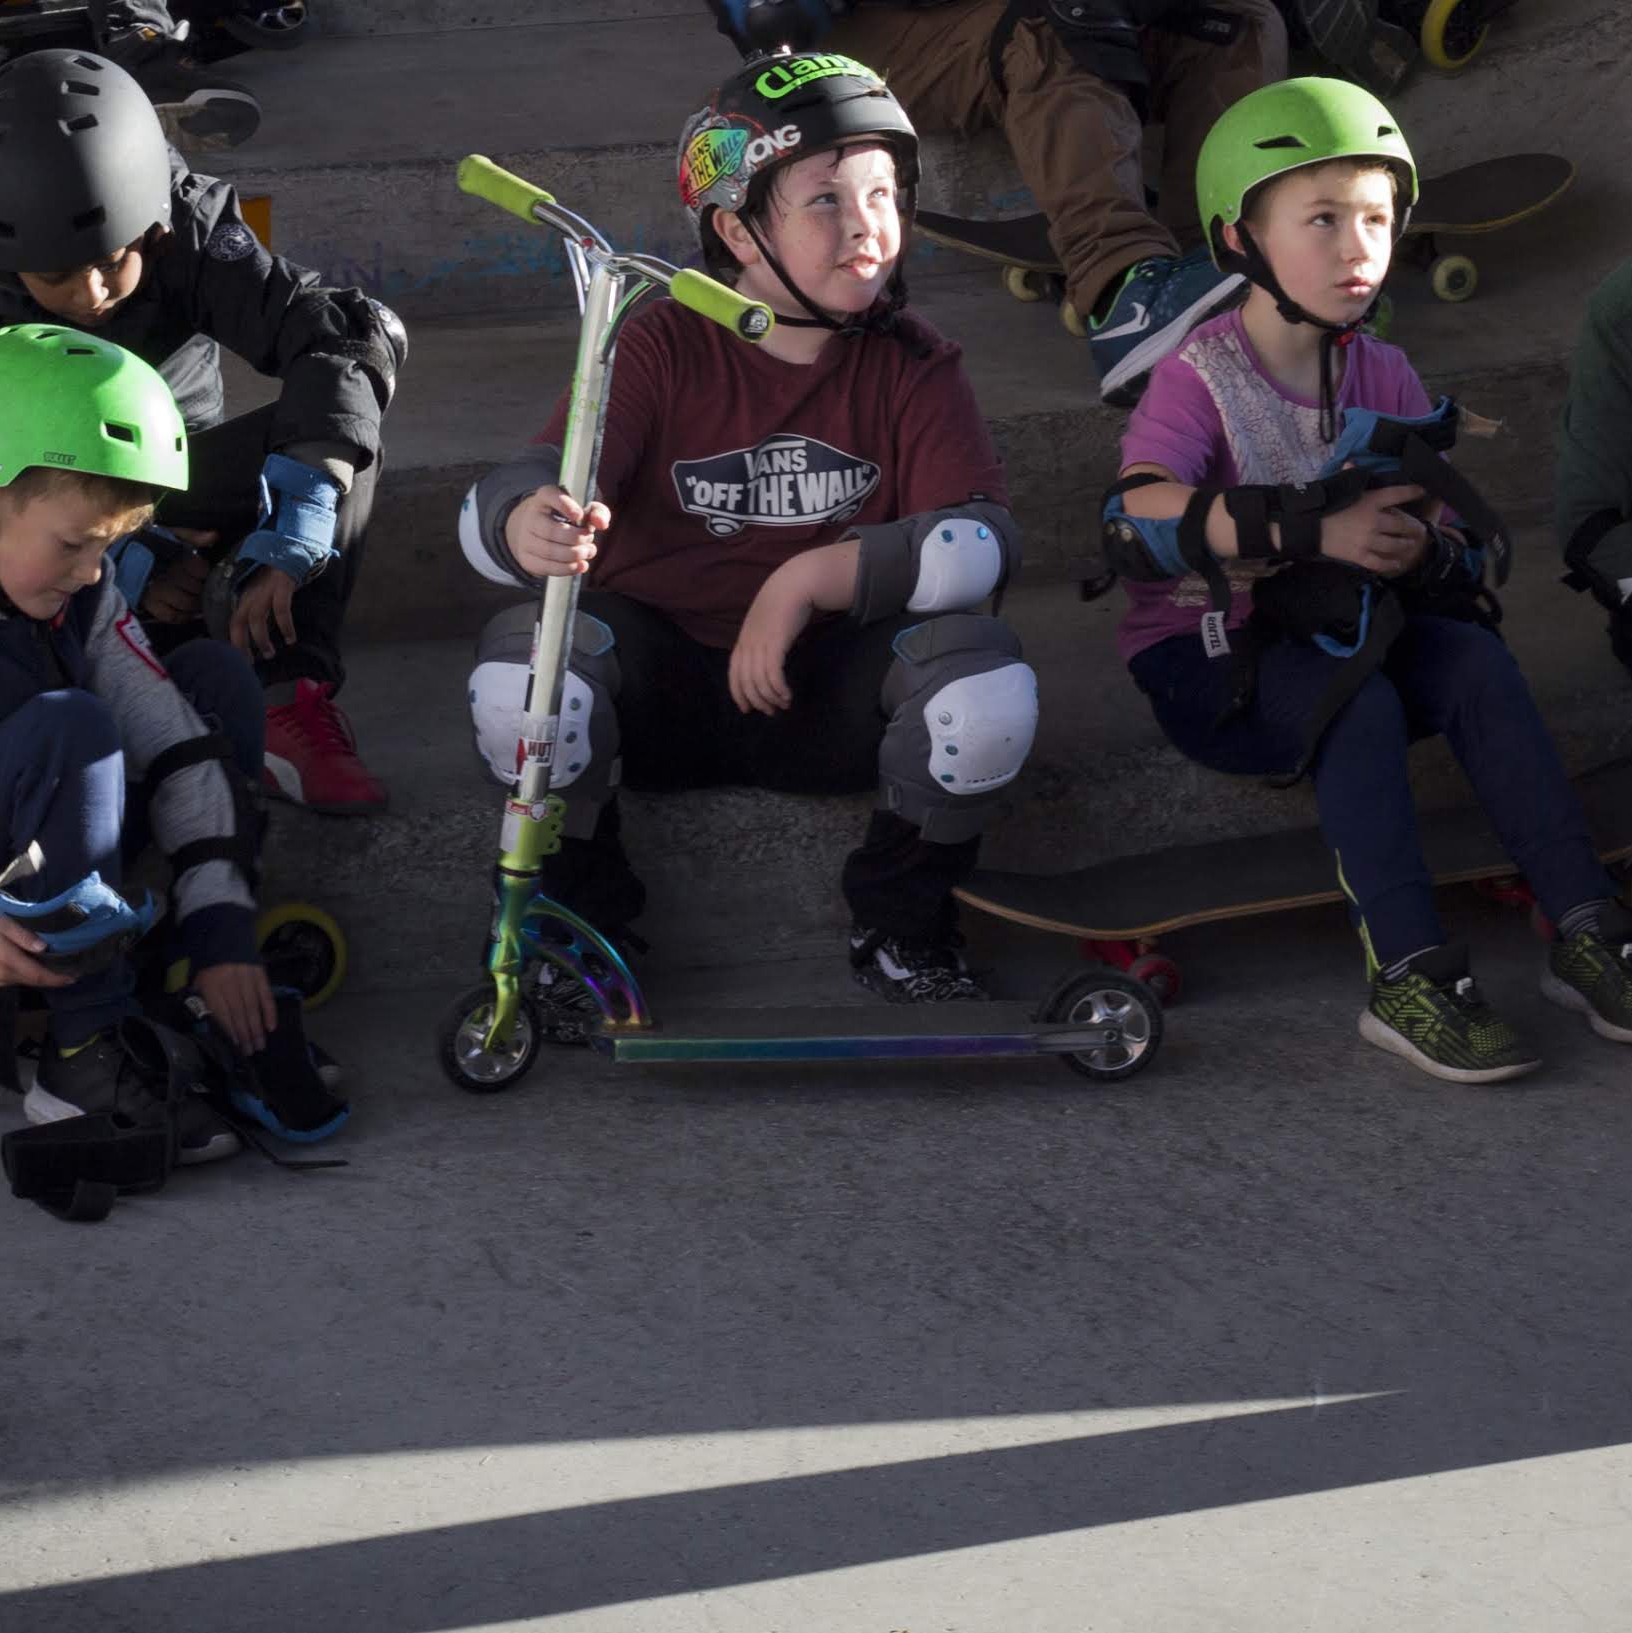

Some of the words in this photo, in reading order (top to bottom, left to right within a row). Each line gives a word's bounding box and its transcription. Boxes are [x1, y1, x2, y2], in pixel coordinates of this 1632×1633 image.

[744, 441, 808, 480] VANS
[685, 475, 744, 511] "OFF
[747, 474, 797, 516] THE
[796, 464, 870, 514] WALL"
[527, 741, 554, 758] HUT
